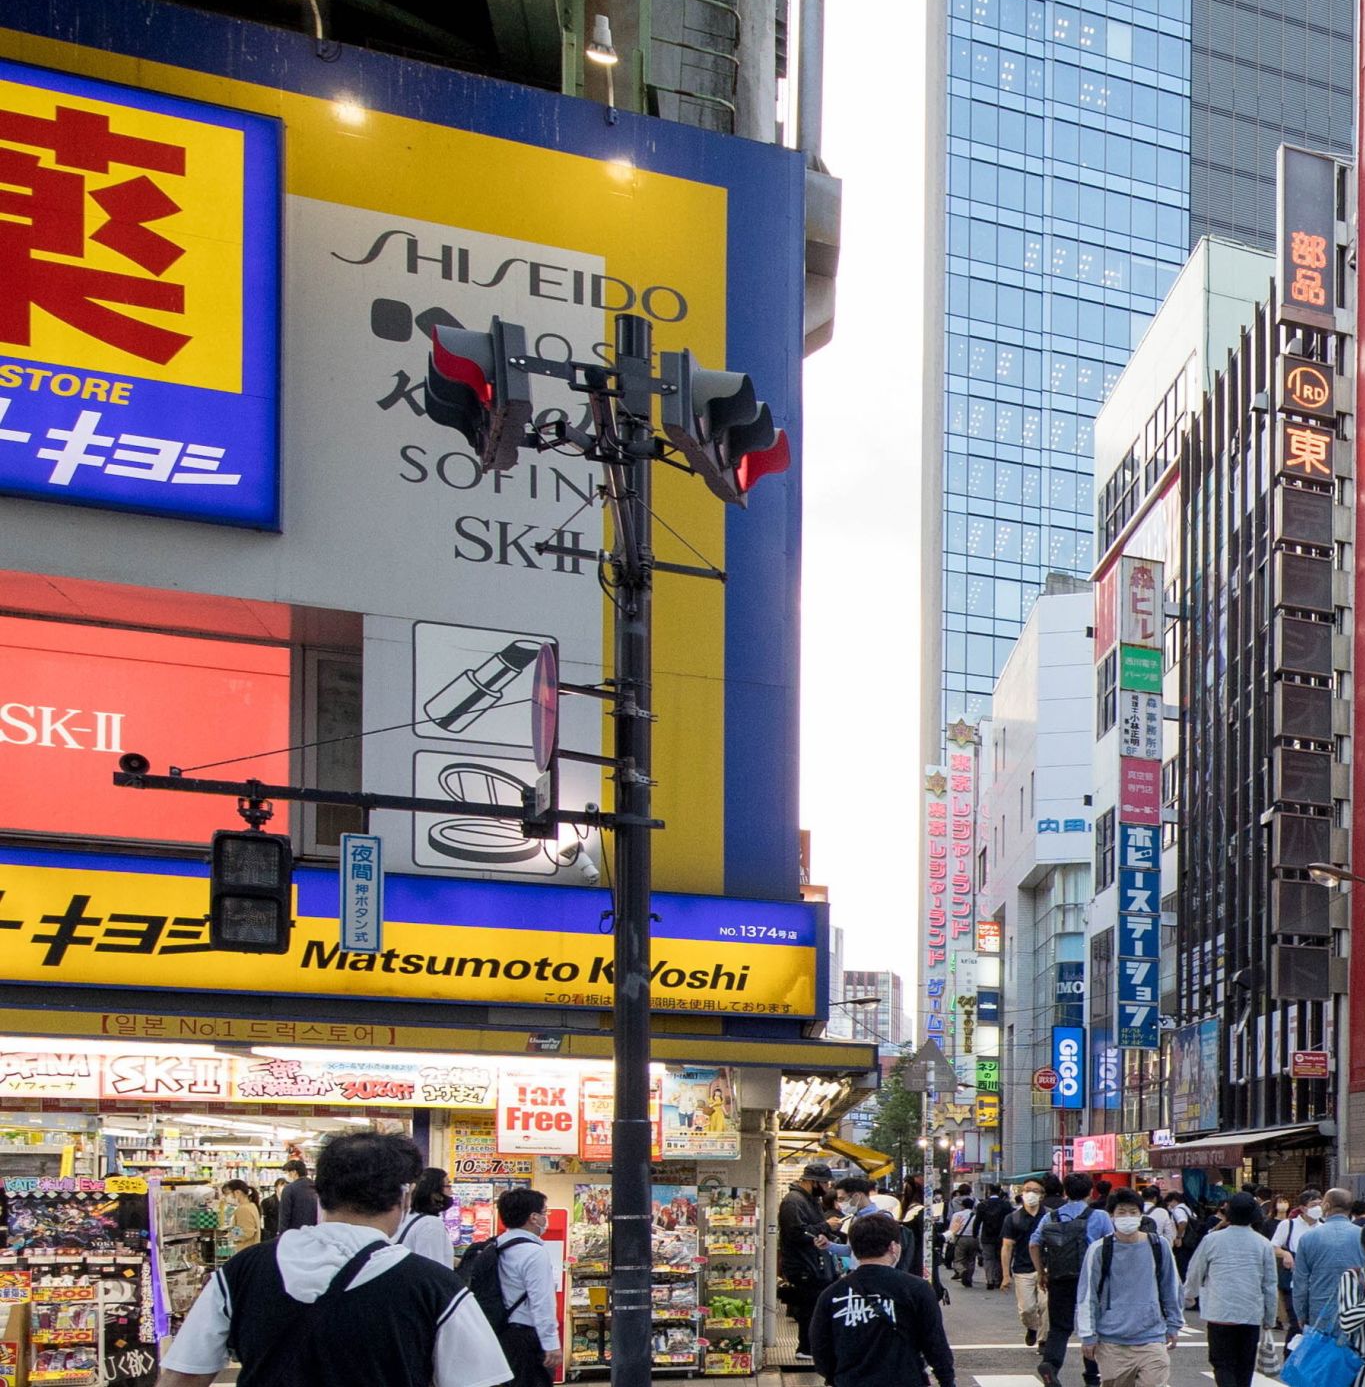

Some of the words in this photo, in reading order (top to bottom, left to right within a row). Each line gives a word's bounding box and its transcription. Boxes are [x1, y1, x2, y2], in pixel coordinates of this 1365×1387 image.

[330, 228, 689, 324] SHISEIDO
[1291, 230, 1328, 307] 部品
[398, 444, 612, 508] SOFIN
[1286, 427, 1331, 475] 東
[0, 702, 126, 754] SK-II
[950, 754, 972, 940] 東京レジャーランド
[1125, 826, 1154, 1028] ホビーステーション
[300, 939, 580, 984] Matsumoto
[179, 1018, 234, 1038] No.1
[247, 1020, 375, 1045] 드럭스토어
[113, 1055, 221, 1095] SK-II
[1058, 1038, 1079, 1097] GiGO
[505, 1106, 573, 1133] Free
[516, 1084, 566, 1107] Tax
